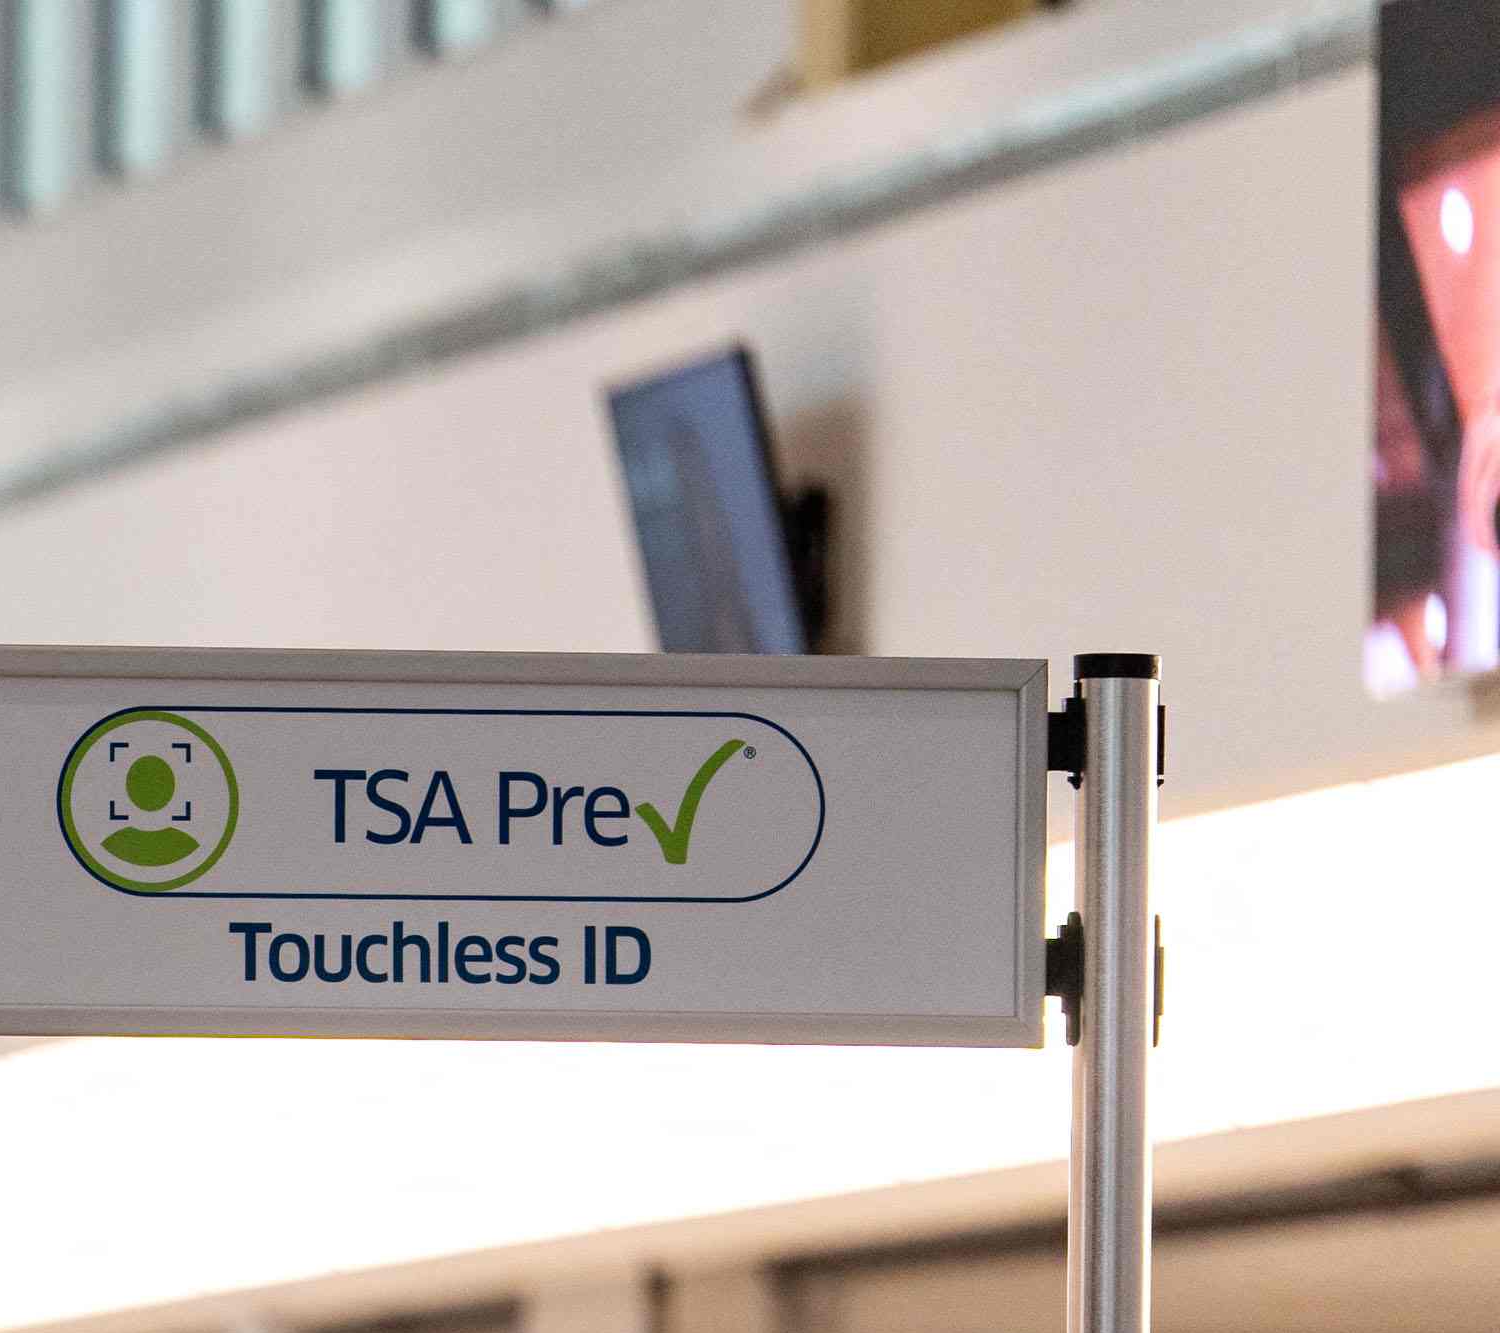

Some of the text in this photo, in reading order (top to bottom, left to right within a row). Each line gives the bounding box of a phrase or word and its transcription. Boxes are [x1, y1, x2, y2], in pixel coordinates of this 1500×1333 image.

[313, 768, 474, 846] TSA
[498, 770, 631, 848] Pre
[228, 920, 652, 985] Touchless ID
